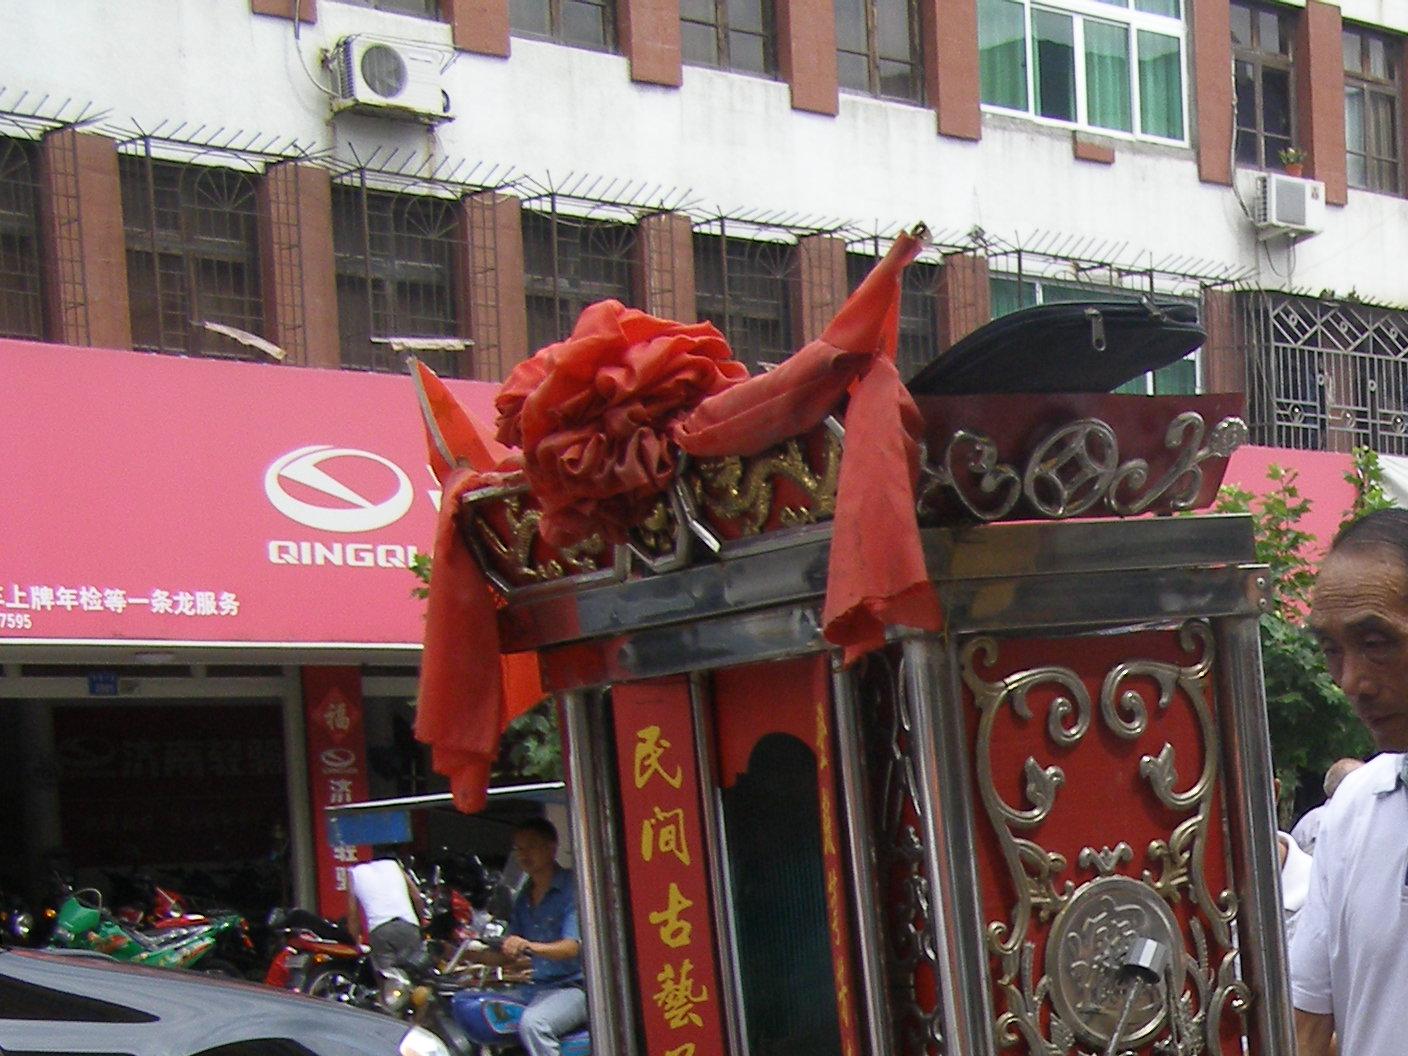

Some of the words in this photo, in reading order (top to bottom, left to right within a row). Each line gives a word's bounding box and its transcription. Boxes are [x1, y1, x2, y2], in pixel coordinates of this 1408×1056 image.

[268, 540, 418, 568] QINGQI
[0, 584, 240, 616] 上牌年检等一条龙服务
